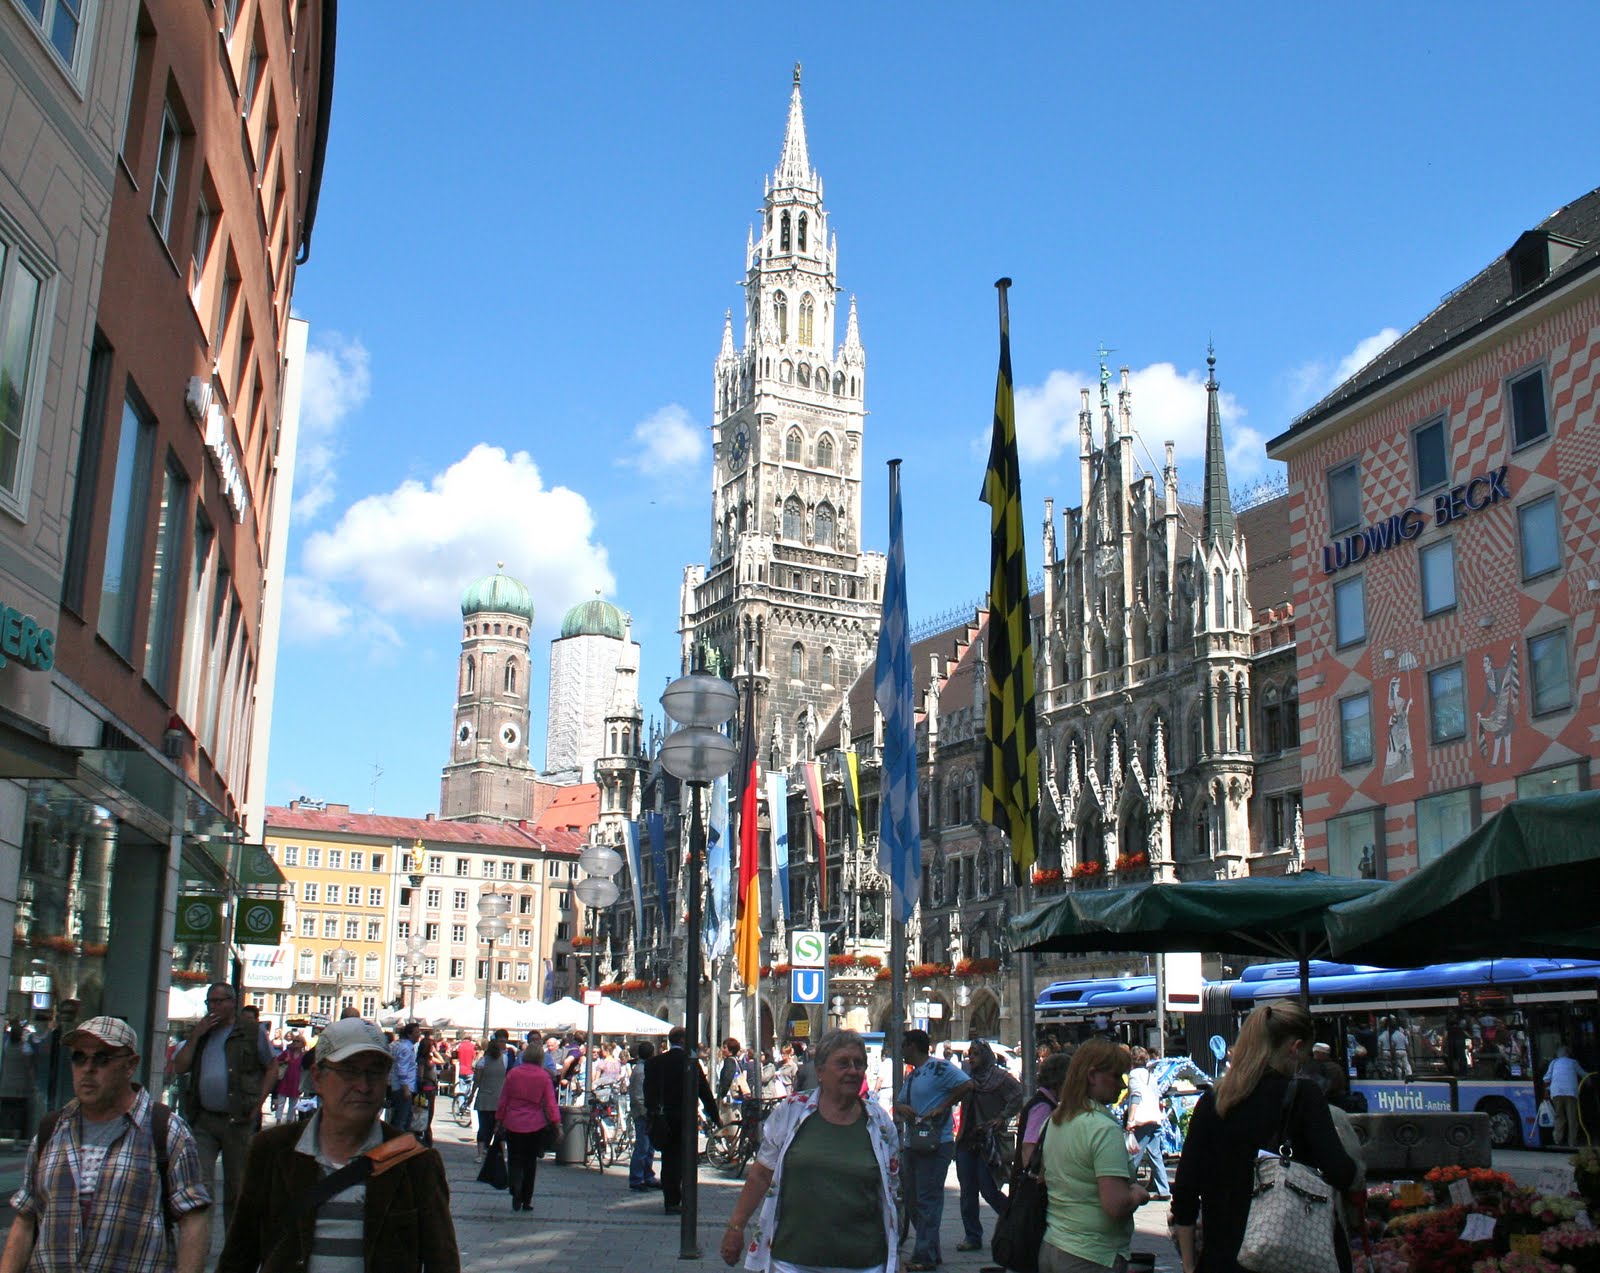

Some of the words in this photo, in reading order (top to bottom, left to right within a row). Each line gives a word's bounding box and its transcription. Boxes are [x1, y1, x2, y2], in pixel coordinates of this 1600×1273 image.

[1323, 507, 1424, 574] LUDWIG
[1433, 466, 1510, 528] BECK
[0, 601, 55, 672] ERS
[797, 935, 822, 961] S
[797, 973, 819, 1000] U
[1378, 1091, 1423, 1112] Hybrid
[1425, 1100, 1451, 1111] -Antrie
